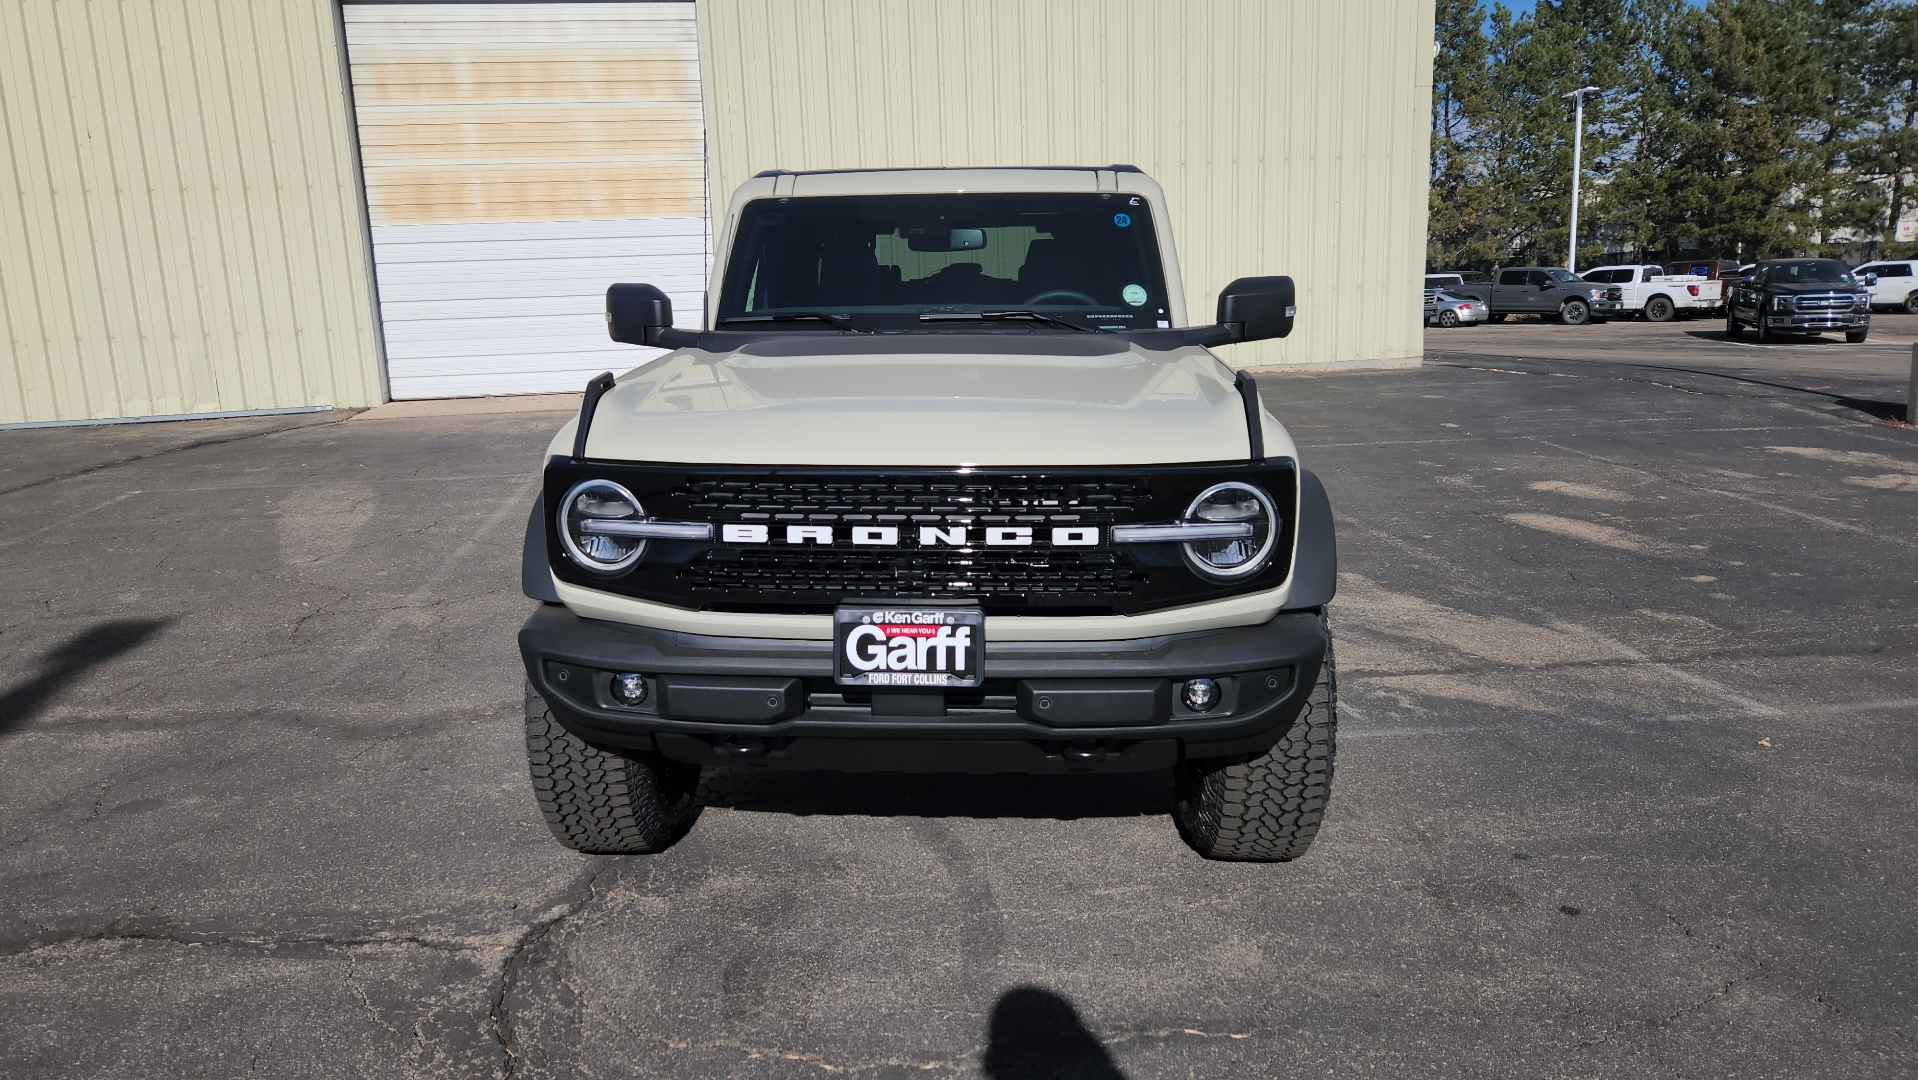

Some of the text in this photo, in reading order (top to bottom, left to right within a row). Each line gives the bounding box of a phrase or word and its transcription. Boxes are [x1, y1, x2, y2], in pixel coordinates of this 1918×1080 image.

[1116, 215, 1127, 224] 24
[722, 524, 1100, 546] BRONCO
[884, 611, 945, 625] Ken Garff
[845, 624, 971, 671] Garff
[868, 673, 948, 685] FORD FORT COLLINS
